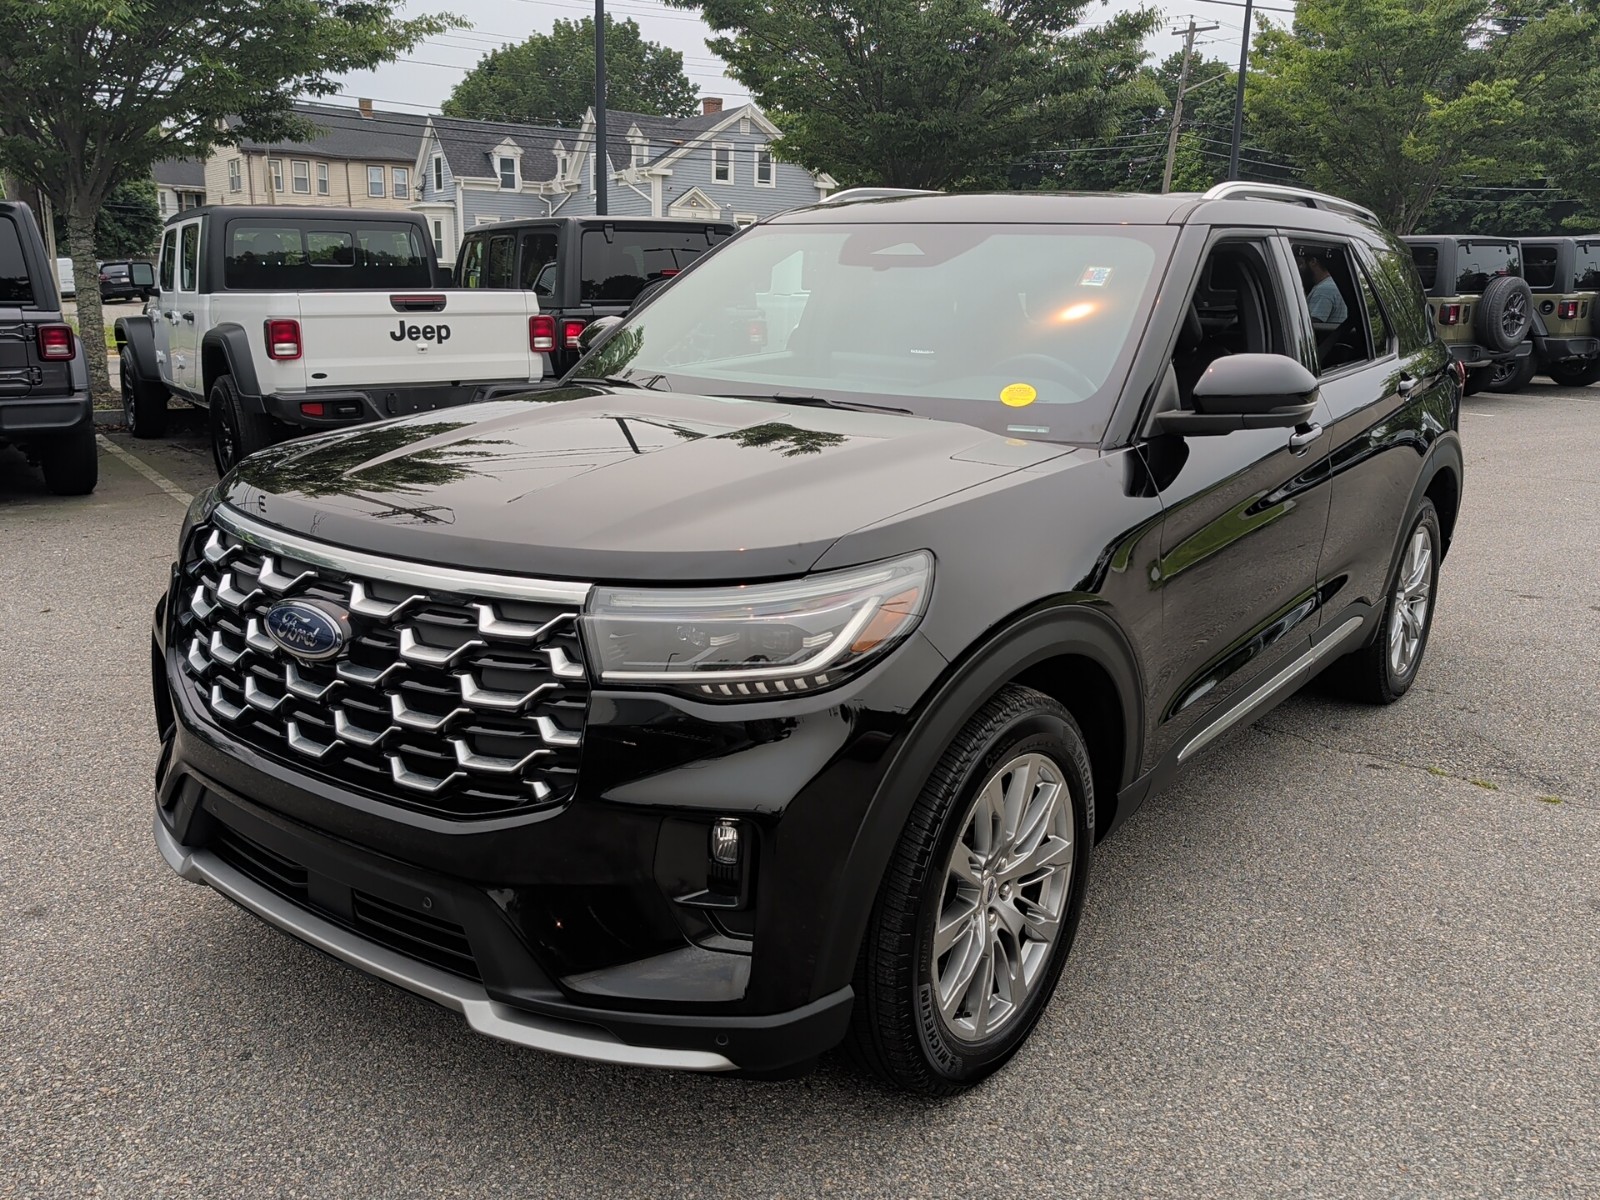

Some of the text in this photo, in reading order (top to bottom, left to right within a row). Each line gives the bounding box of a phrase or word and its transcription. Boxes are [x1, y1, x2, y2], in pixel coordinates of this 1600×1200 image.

[390, 320, 451, 344] Jeep
[277, 612, 320, 647] Ford
[1076, 750, 1095, 825] MICHELIN
[920, 988, 950, 1065] MICHELIN
